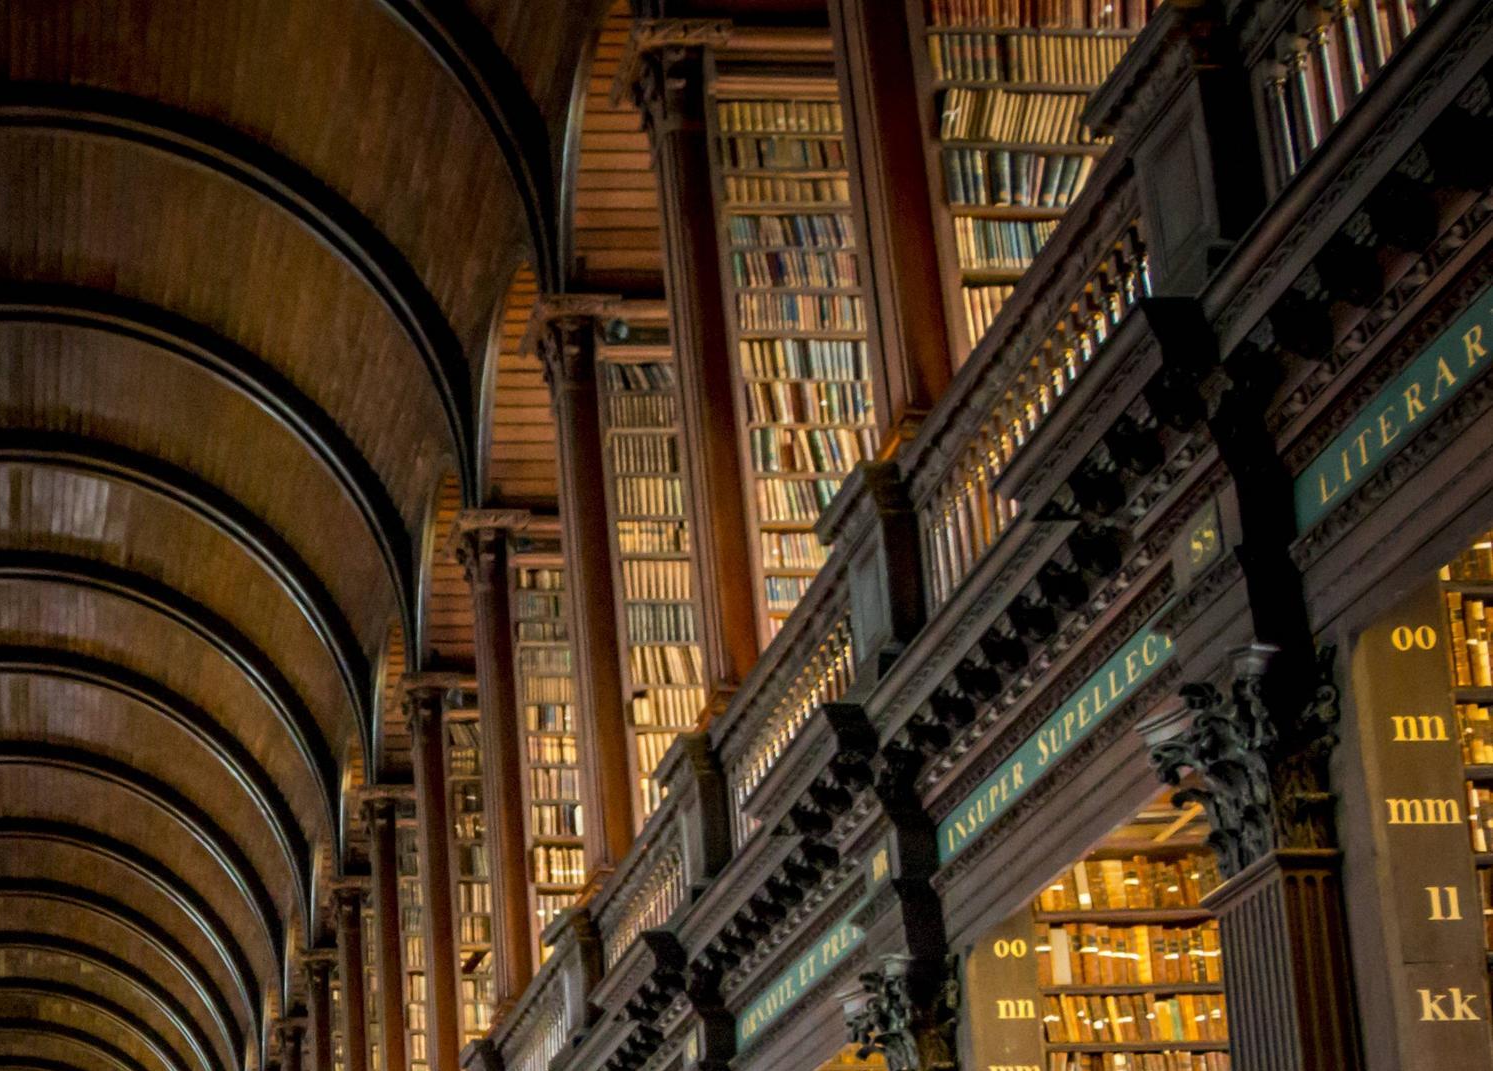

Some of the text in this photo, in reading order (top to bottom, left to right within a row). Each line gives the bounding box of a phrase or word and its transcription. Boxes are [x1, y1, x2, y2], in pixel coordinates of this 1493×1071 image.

[1320, 308, 1493, 505] LITERAR
[1391, 625, 1437, 652] oo
[1391, 715, 1450, 742] nn
[946, 762, 1025, 853] INSUPER
[1385, 798, 1462, 825] mm
[1424, 886, 1463, 921] ll
[993, 939, 1028, 959] oo
[798, 955, 816, 986] ET
[996, 999, 1036, 1020] nn
[1416, 987, 1481, 1022] kk
